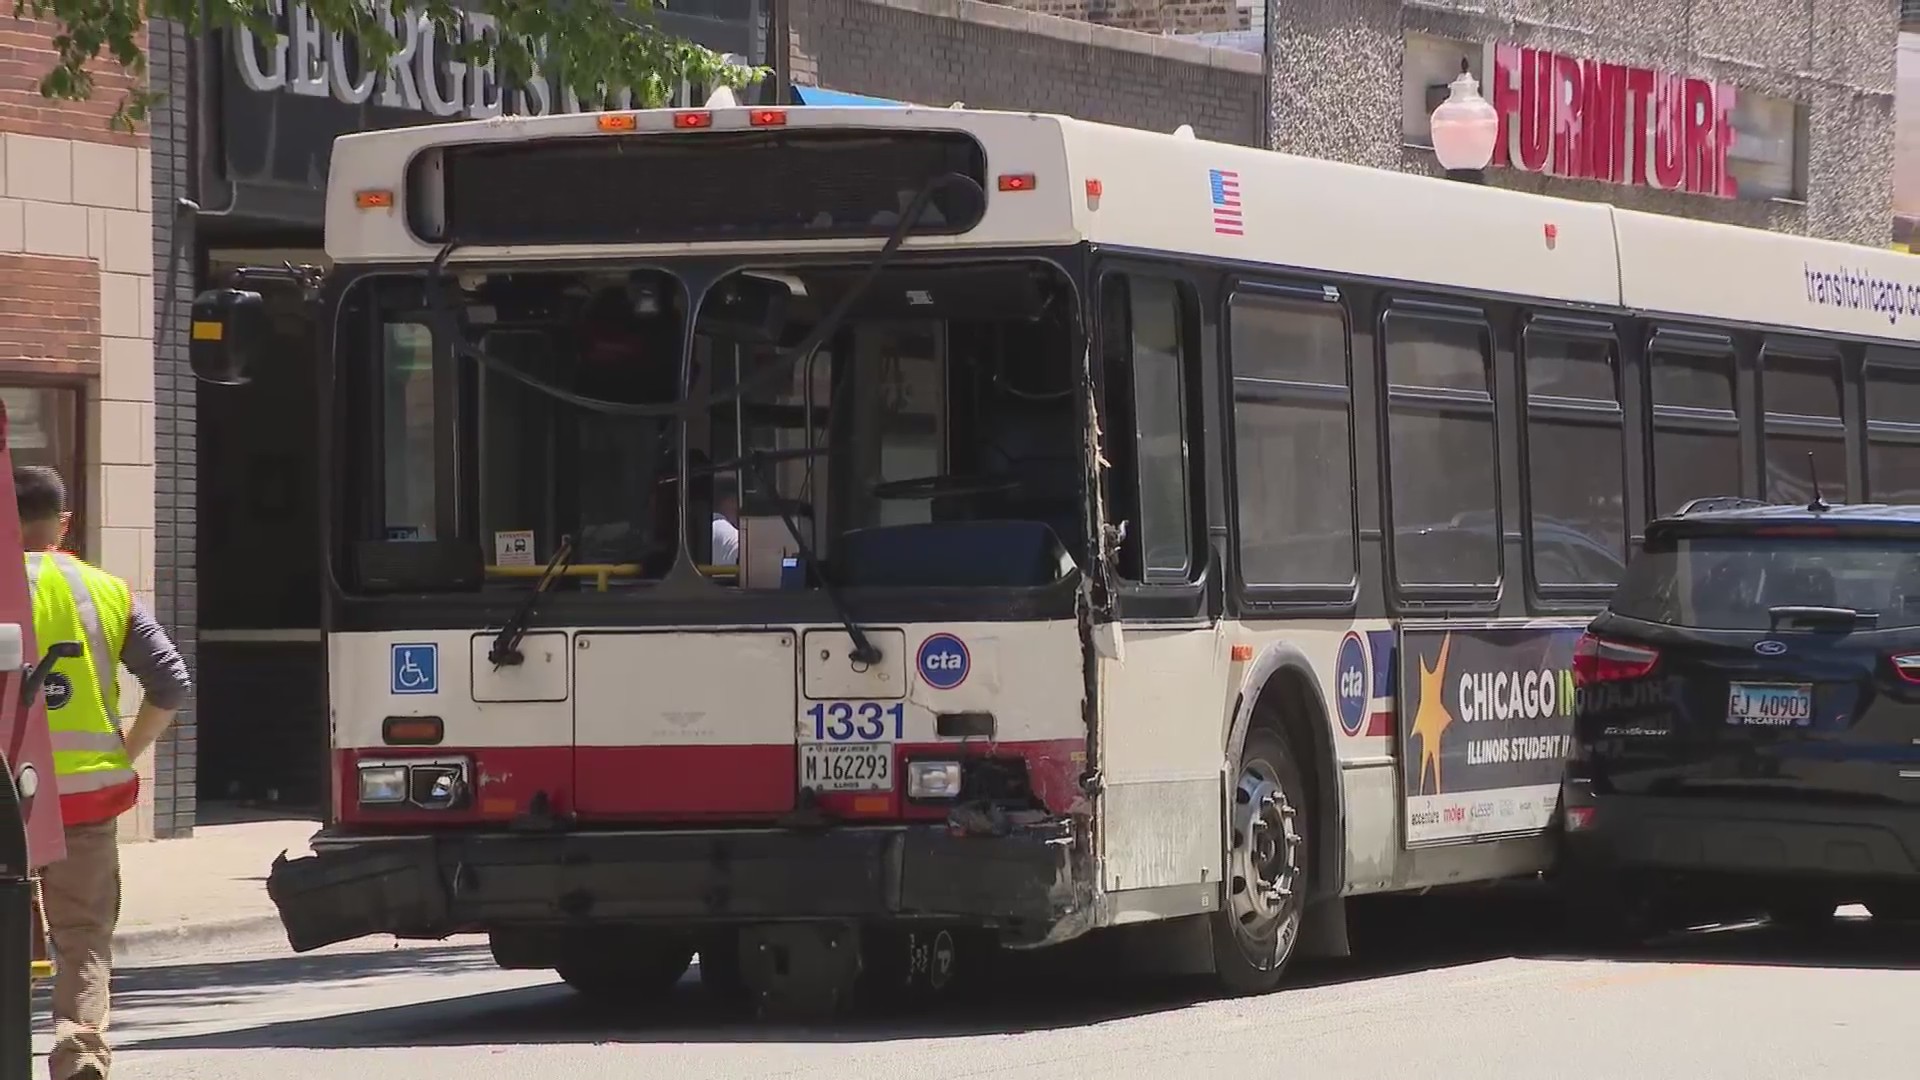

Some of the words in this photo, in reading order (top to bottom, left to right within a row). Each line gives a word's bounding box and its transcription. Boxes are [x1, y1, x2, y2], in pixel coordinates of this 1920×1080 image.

[1493, 42, 1738, 200] FURNITURE
[926, 652, 962, 670] cta
[1341, 665, 1363, 698] cta
[1459, 669, 1556, 723] CHICAGO
[806, 702, 904, 741] 1331
[1731, 694, 1751, 716] EJ
[1760, 694, 1809, 717] 40903
[1467, 738, 1509, 766] ILLINOIS
[1510, 735, 1560, 762] STUDENT
[806, 755, 817, 781] M
[822, 754, 888, 781] 162293
